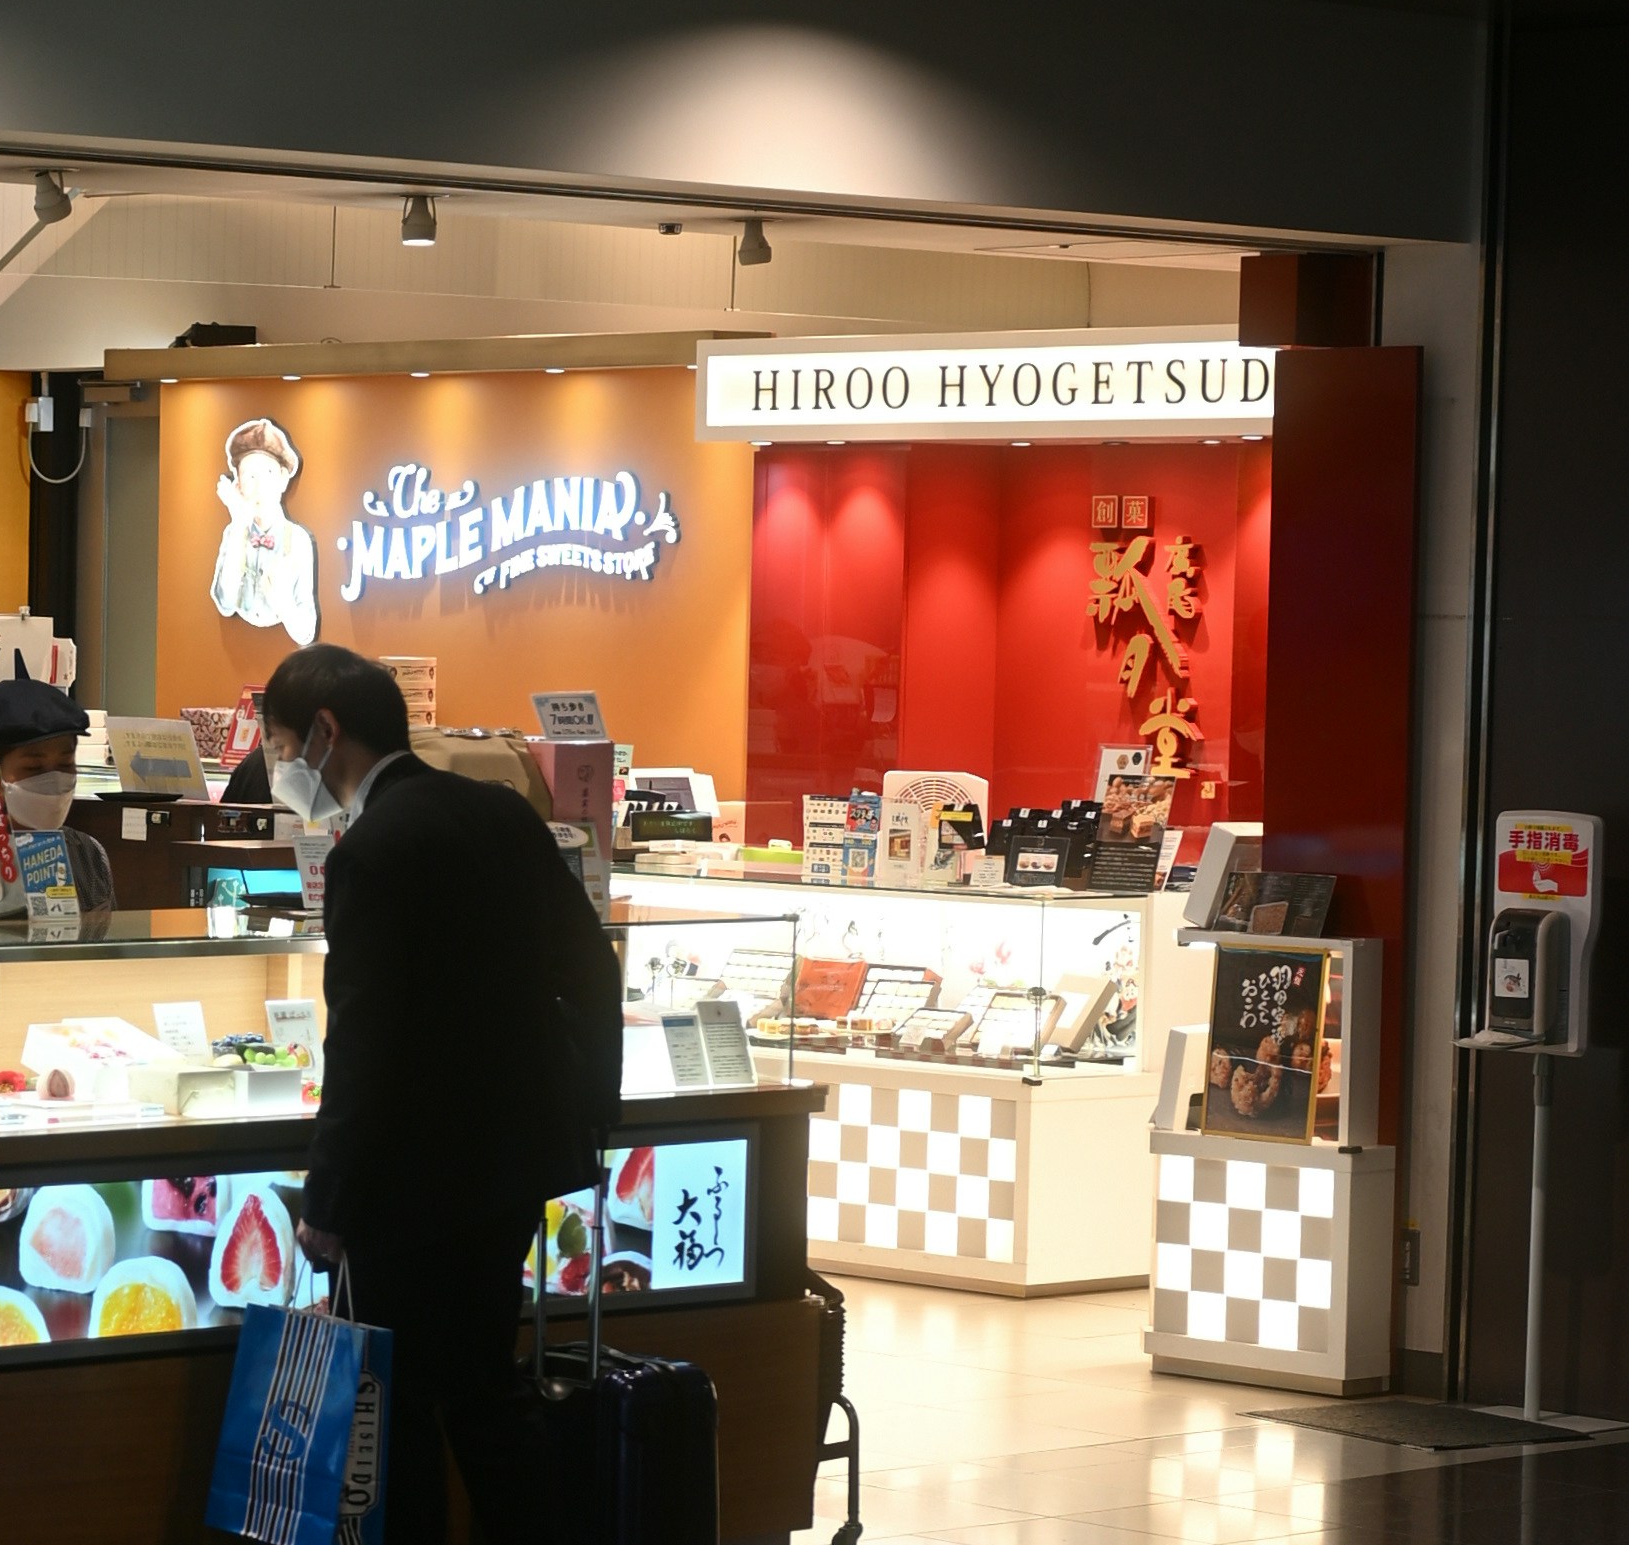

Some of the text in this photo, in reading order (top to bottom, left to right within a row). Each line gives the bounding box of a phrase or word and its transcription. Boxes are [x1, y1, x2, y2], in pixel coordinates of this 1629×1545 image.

[752, 358, 1270, 411] HIROO HYOGETSUD
[388, 463, 443, 518] The
[340, 470, 637, 601] MAPLE MANIA
[23, 844, 64, 871] HANEDA
[1508, 830, 1580, 852] 手指消毒
[26, 863, 56, 886] POINT
[1239, 978, 1258, 1029] おこわ
[672, 1188, 705, 1271] 大福
